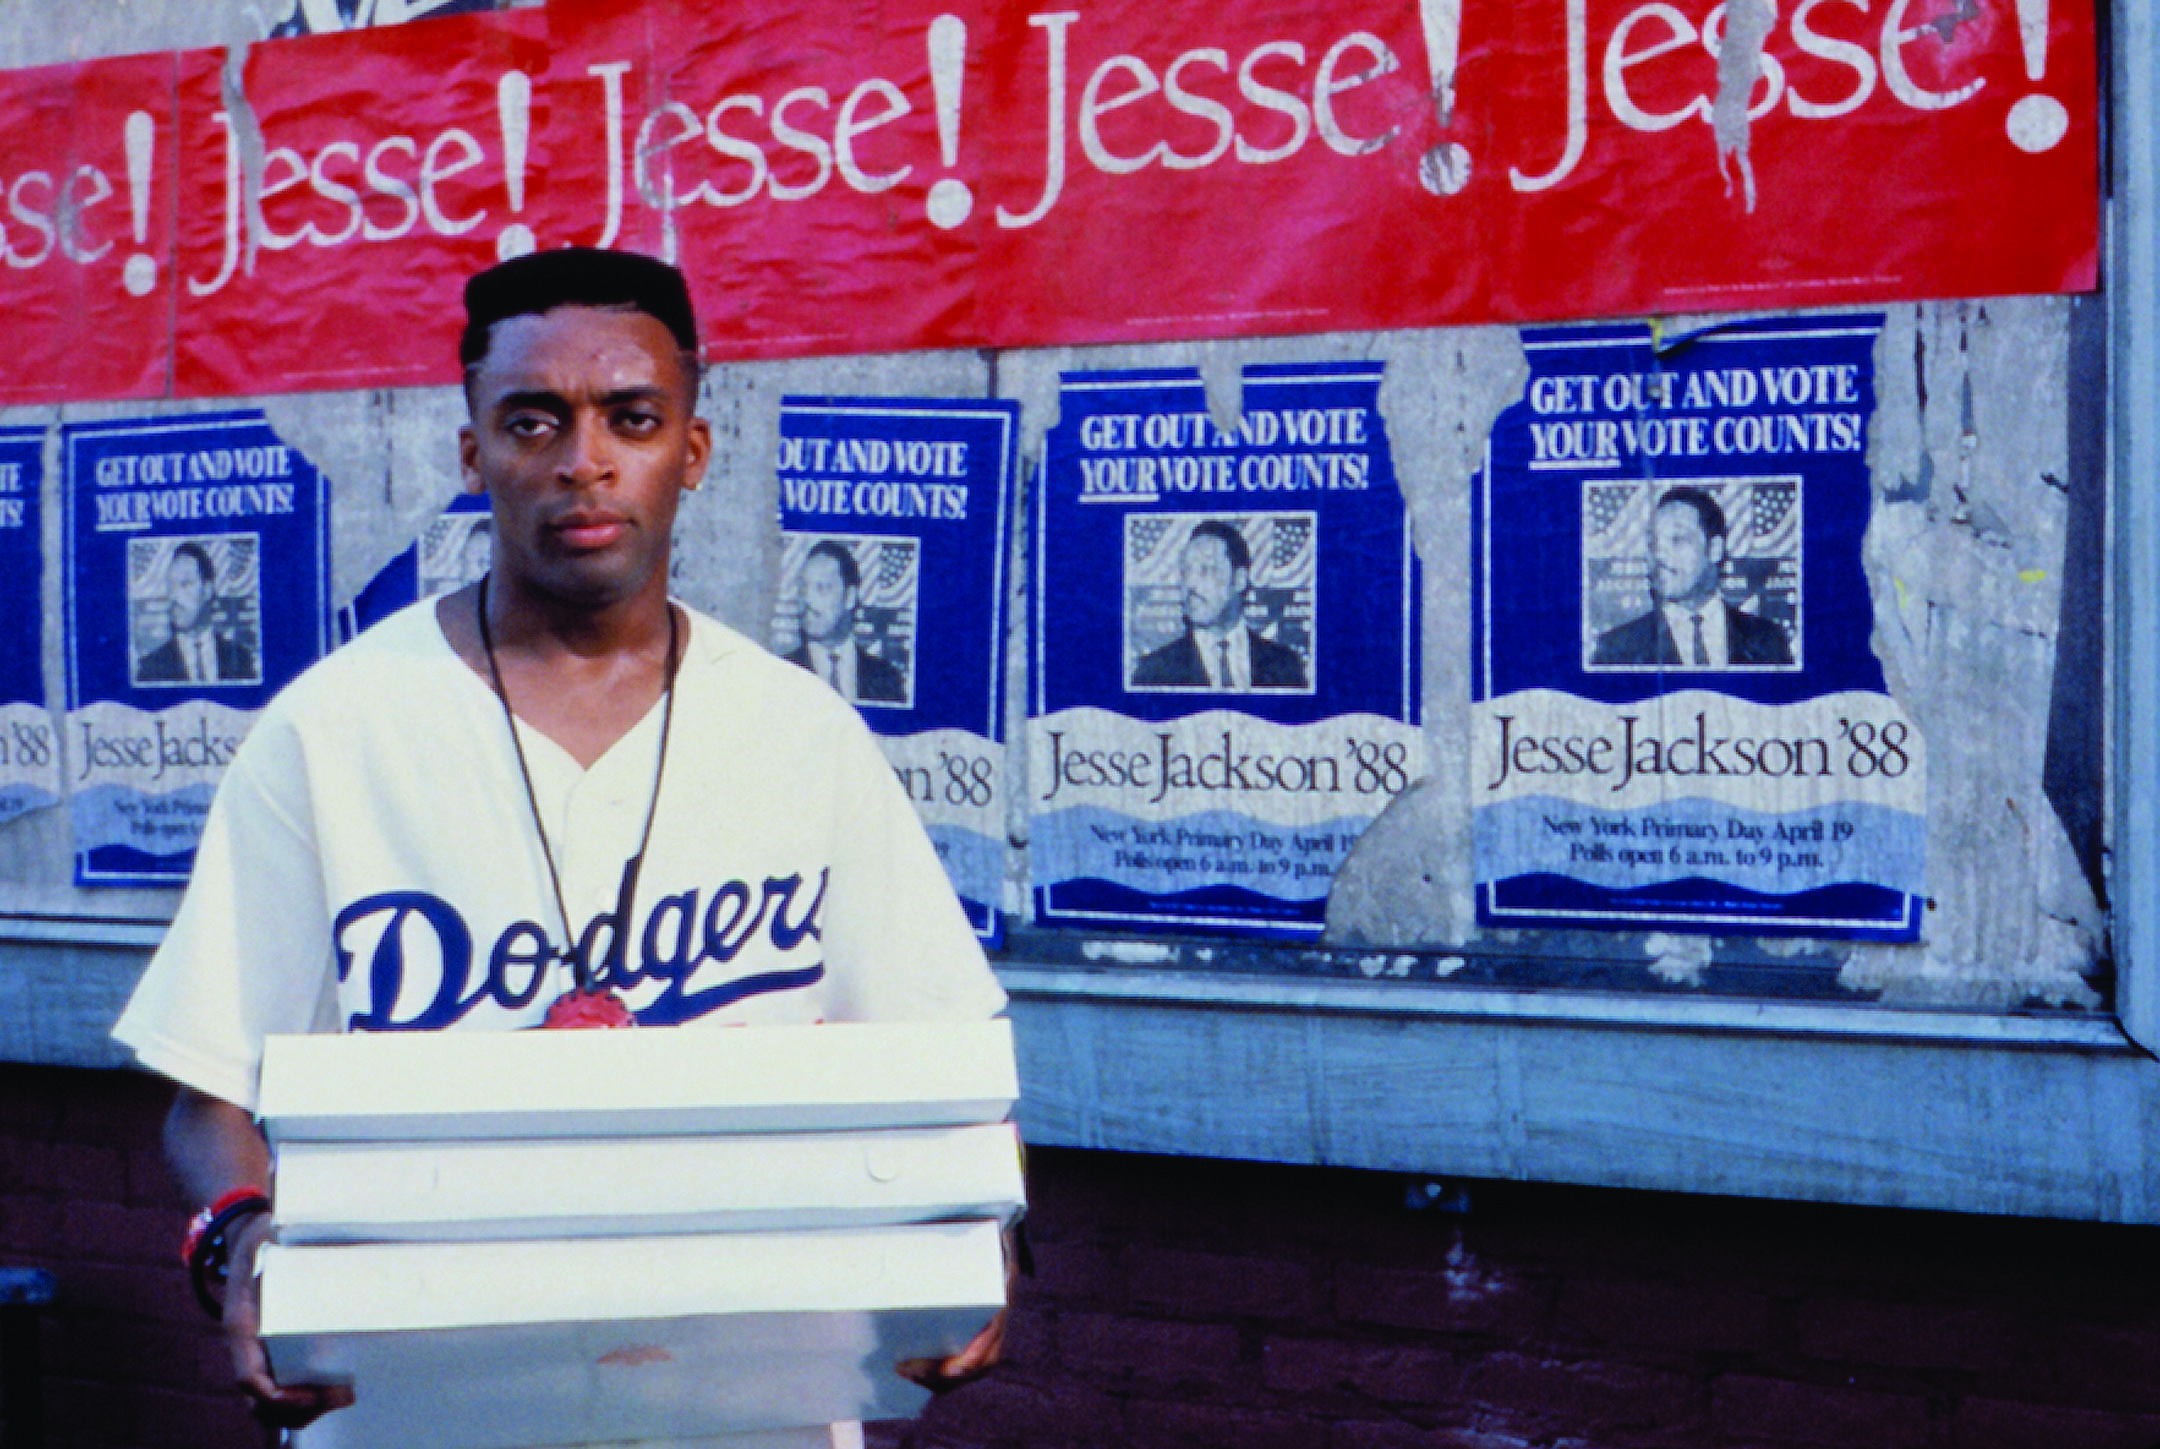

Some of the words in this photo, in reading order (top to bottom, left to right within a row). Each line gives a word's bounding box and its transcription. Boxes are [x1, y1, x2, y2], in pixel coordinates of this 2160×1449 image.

[0, 110, 157, 297] se!
[189, 69, 538, 297] Jesse!
[565, 13, 973, 249] Jesse!
[996, 0, 1474, 229] Jesse!
[1530, 374, 1600, 415] GET
[1603, 372, 1680, 411] OUT
[1681, 368, 1759, 410] AND
[1760, 364, 1859, 406] VOTE
[1080, 413, 1142, 450] GET
[1143, 411, 1210, 449] OUT
[1281, 407, 1368, 446] VOTE
[1529, 420, 1620, 460] YOUR
[1620, 416, 1710, 457] VOTE
[1713, 413, 1862, 454] COUNTS!
[95, 454, 139, 488] GET
[139, 452, 185, 486] OUT
[185, 449, 233, 482] AND
[233, 445, 293, 479] VOTE
[776, 437, 832, 473] OUT
[831, 438, 891, 474] AND
[893, 440, 968, 477] VOTE
[1079, 456, 1158, 493] YOUR
[1158, 455, 1238, 493] VOTE
[1238, 452, 1370, 492] COUNTS!
[95, 491, 151, 523] YOUR
[151, 487, 203, 520] VOTE
[783, 478, 851, 515] VOTE
[852, 480, 969, 520] COUNTS!
[79, 721, 153, 781] Jesse
[1042, 731, 1152, 802] Jesse
[1150, 729, 1342, 804] Jackson
[1346, 736, 1409, 795] '88
[1487, 714, 1614, 792] Jesse
[1611, 711, 1833, 792] Jackson
[1838, 716, 1910, 779] '88
[1727, 818, 1764, 845] Day
